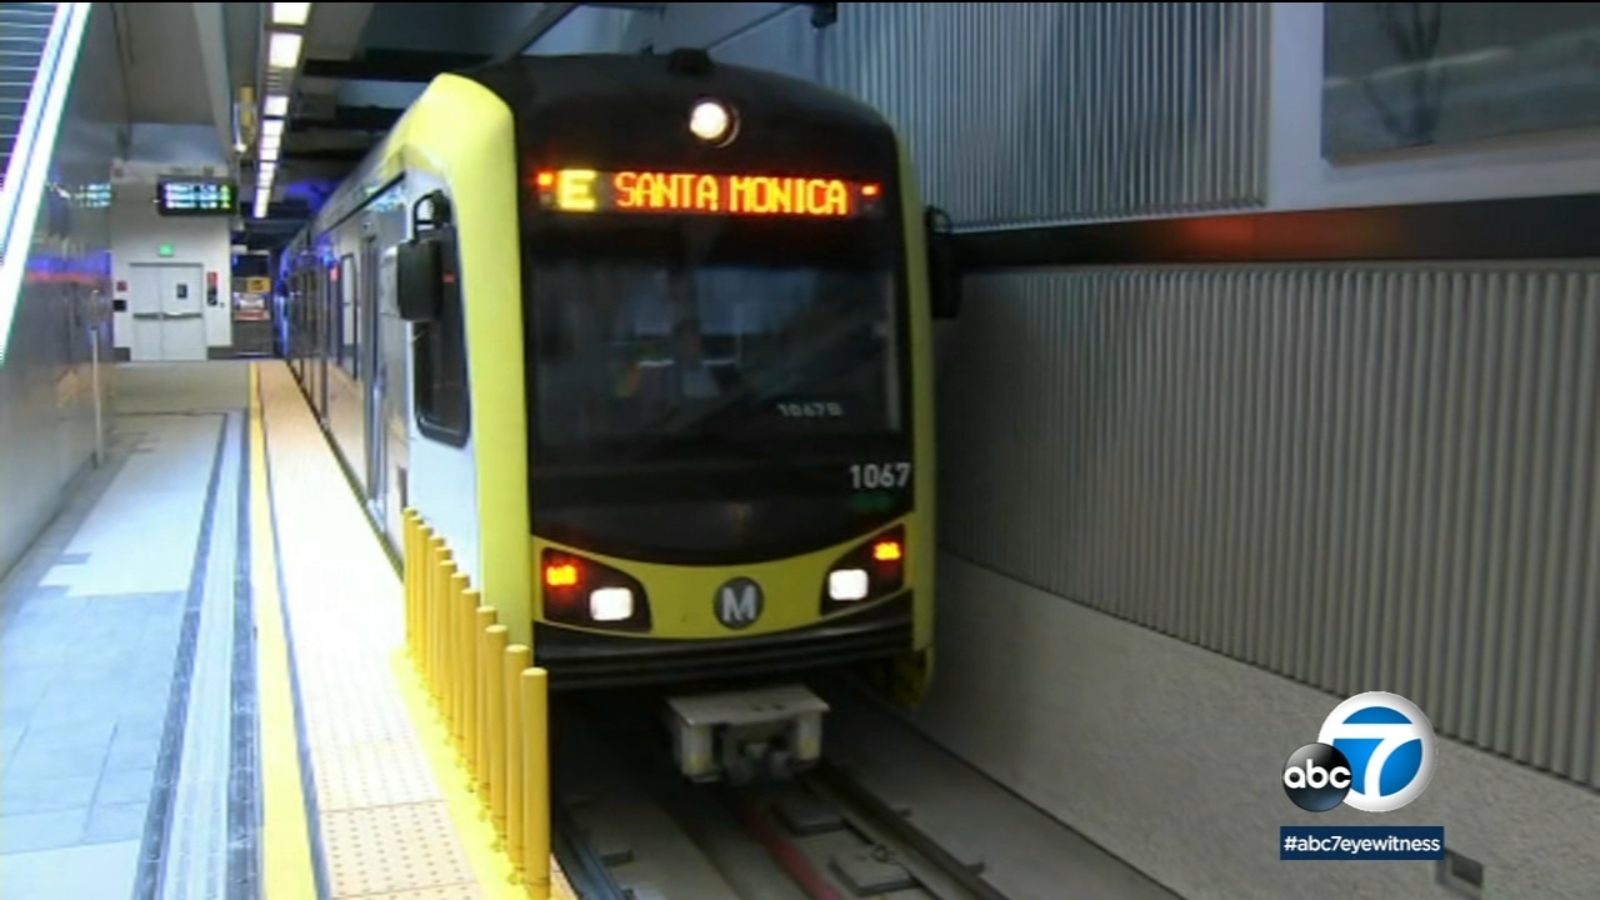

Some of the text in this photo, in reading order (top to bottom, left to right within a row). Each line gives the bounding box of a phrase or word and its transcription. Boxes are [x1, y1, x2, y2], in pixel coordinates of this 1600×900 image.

[558, 169, 848, 216] E SANTA MONICA
[850, 463, 911, 489] 1067
[721, 586, 756, 621] M
